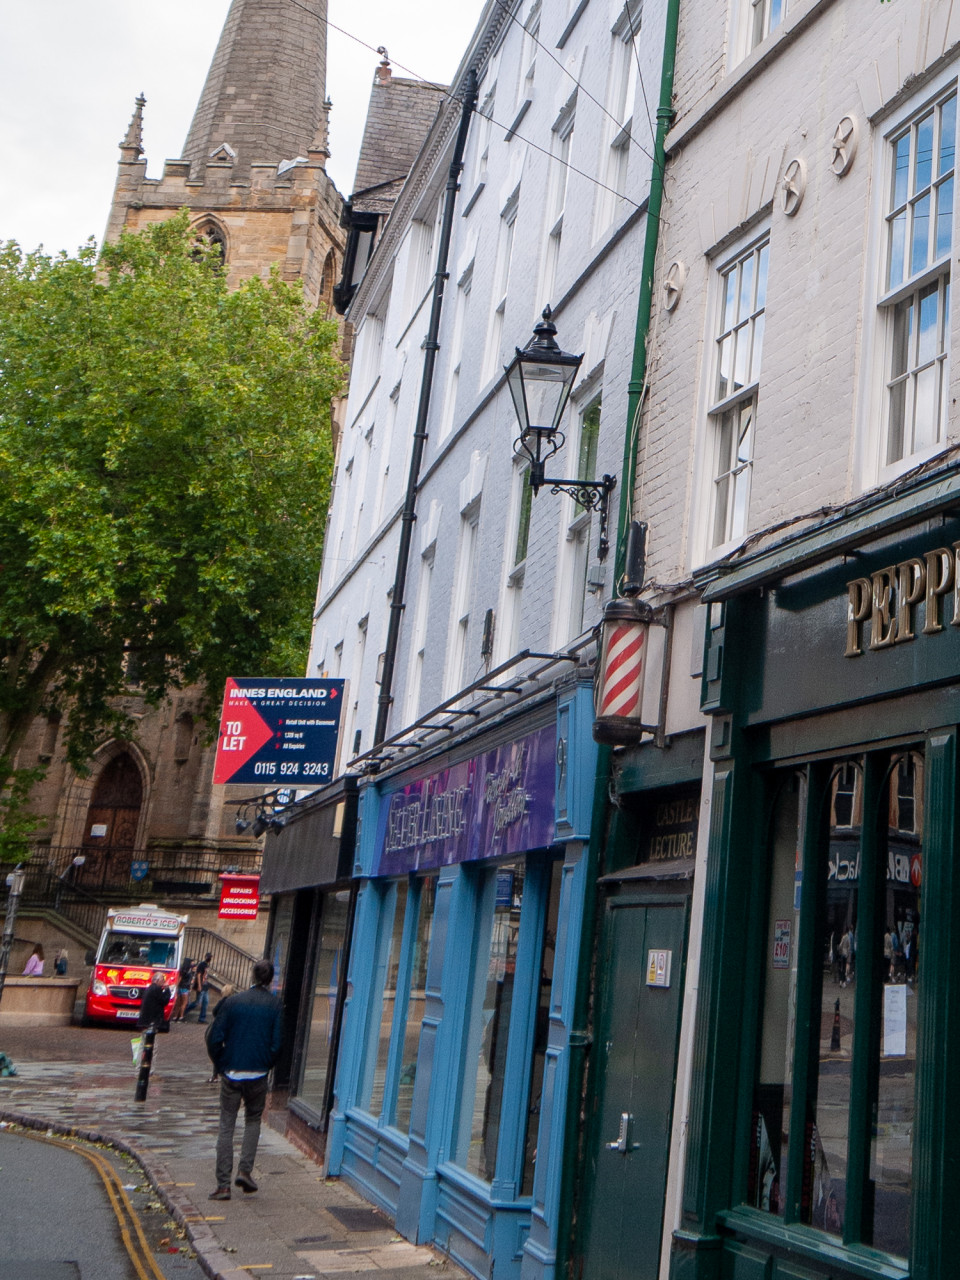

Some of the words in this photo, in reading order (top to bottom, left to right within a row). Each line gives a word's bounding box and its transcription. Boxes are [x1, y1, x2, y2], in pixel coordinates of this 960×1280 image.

[230, 688, 266, 698] INNES
[267, 688, 327, 699] ENGLAND
[226, 721, 242, 735] TO
[222, 736, 246, 751] LET
[254, 762, 277, 775] 0115
[280, 762, 299, 775] 924
[303, 762, 329, 776] 3243
[649, 831, 694, 859] LECTURE
[230, 887, 253, 895] REPAIRS
[222, 897, 257, 905] UNLOCKING
[220, 907, 257, 915] ACCESSORIES
[115, 915, 159, 927] ROBERTO'S
[160, 919, 178, 929] ICES
